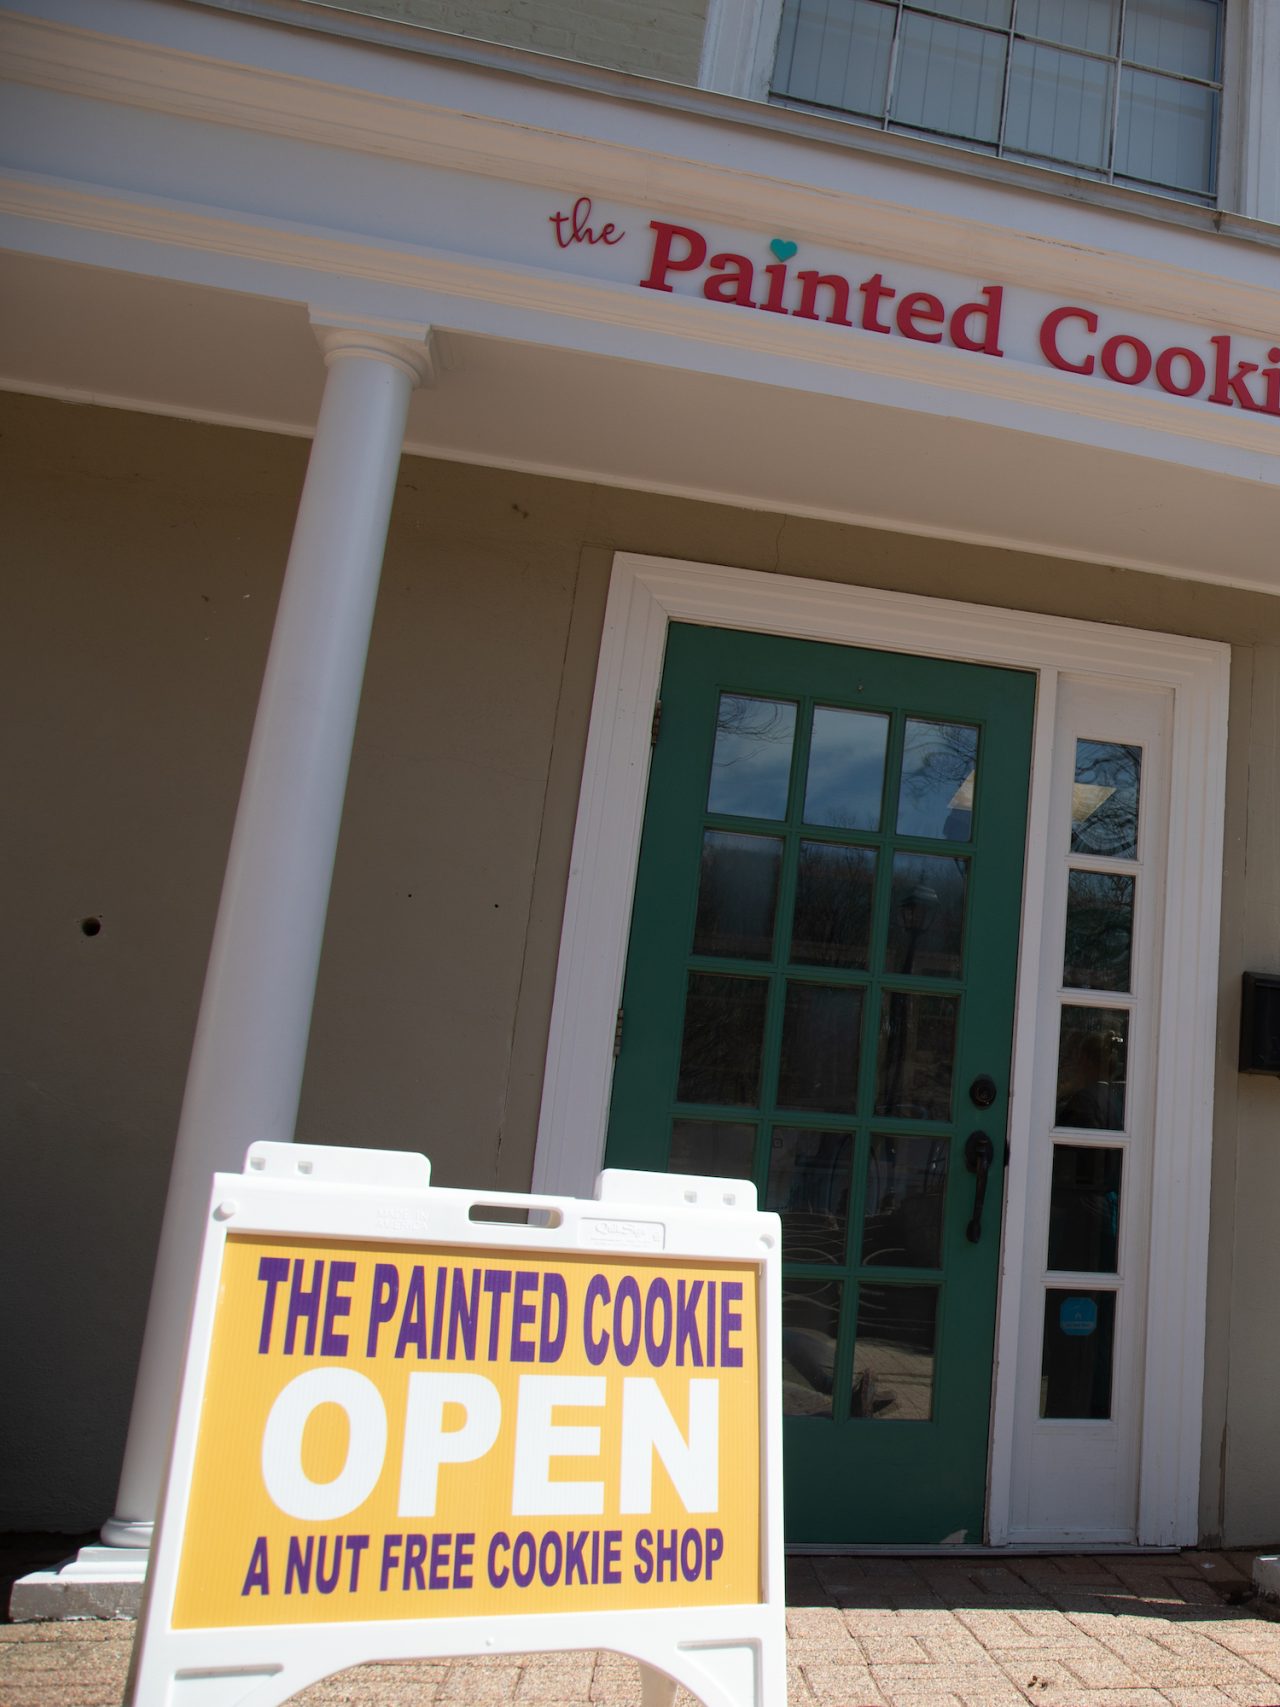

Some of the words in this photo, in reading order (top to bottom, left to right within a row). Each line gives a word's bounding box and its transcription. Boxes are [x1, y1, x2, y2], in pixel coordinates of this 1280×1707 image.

[548, 197, 625, 249] the
[639, 220, 1004, 358] Painted
[258, 1257, 356, 1357] THE
[366, 1263, 568, 1363] PAINTED
[583, 1273, 744, 1367] COOKIE
[261, 1367, 720, 1520] OPEN
[241, 1536, 271, 1596] A
[284, 1534, 370, 1594] NUT
[380, 1533, 476, 1592] FREE
[488, 1530, 622, 1589] COOKIE
[633, 1528, 725, 1583] SHOP
